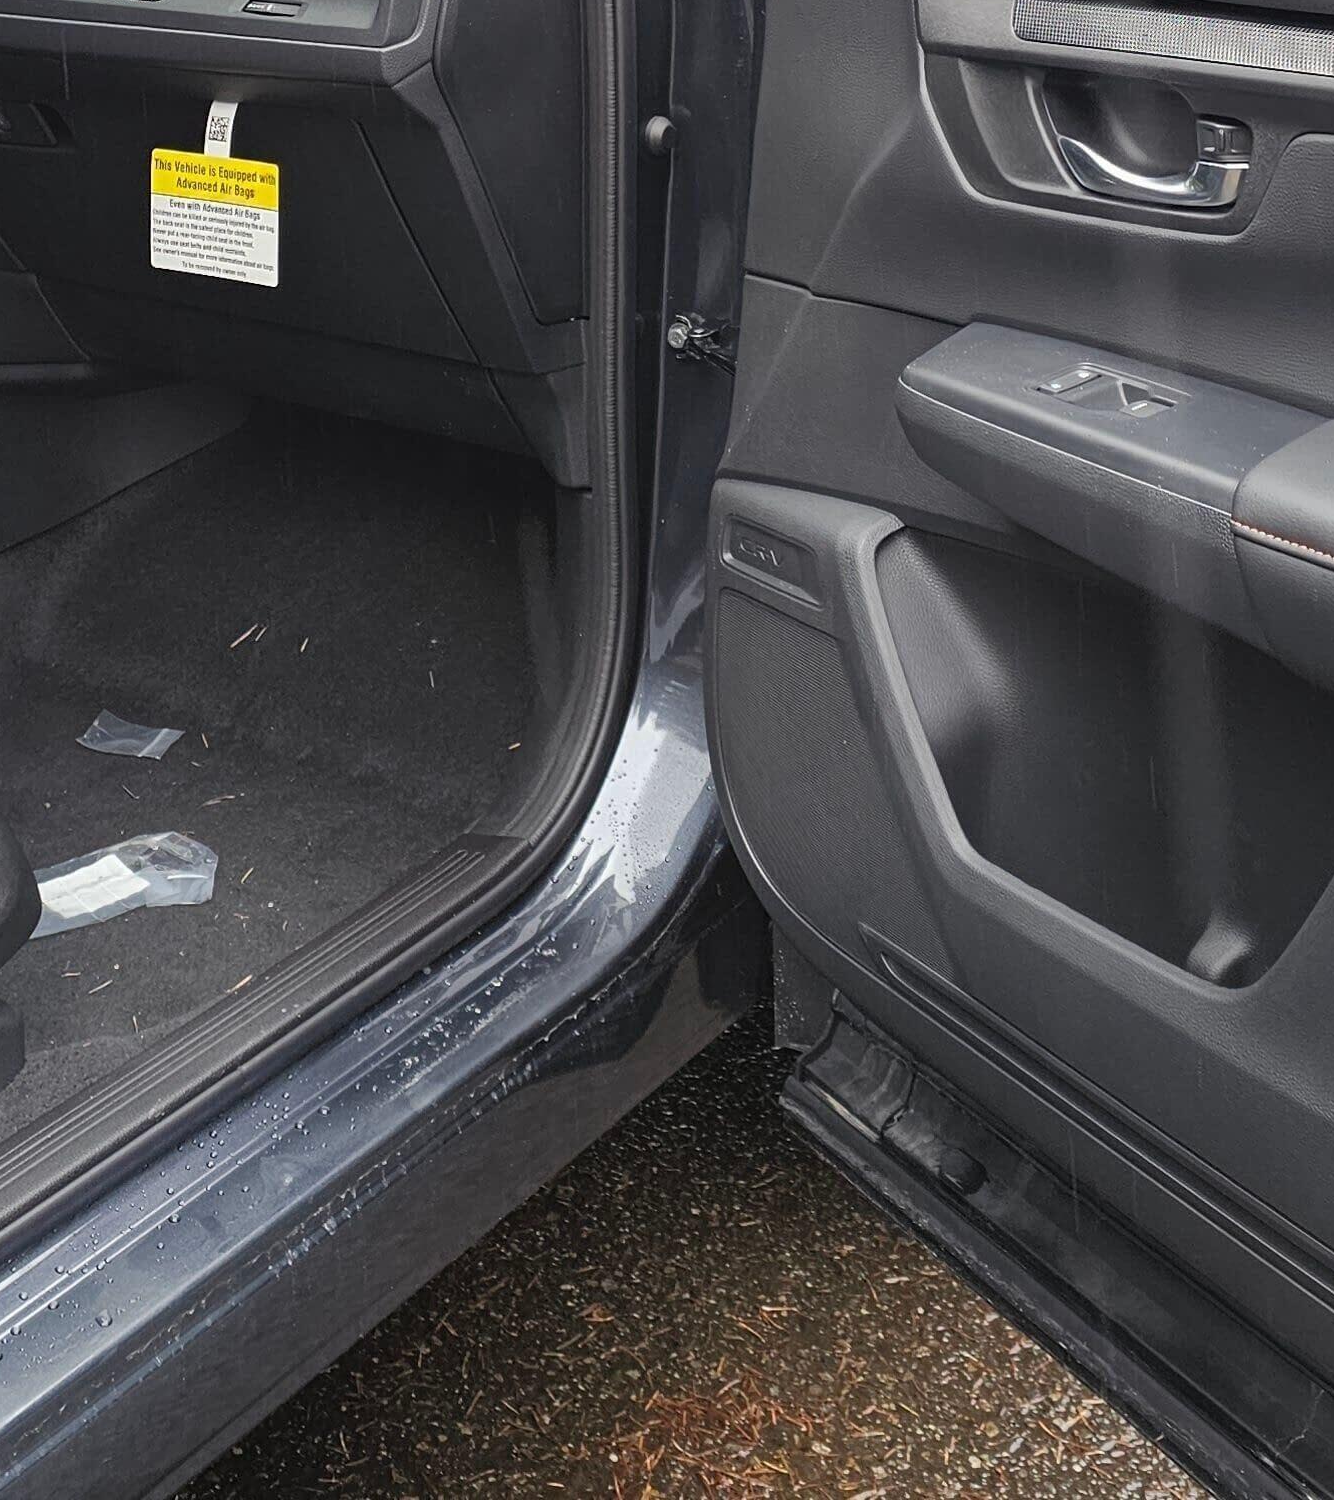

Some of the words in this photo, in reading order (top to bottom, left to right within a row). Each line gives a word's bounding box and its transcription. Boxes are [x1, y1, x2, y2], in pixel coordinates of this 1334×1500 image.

[155, 158, 172, 171] This
[175, 161, 206, 175] Vehicle
[209, 166, 216, 177] is
[219, 167, 257, 184] Equipped
[259, 173, 276, 185] with
[177, 177, 217, 193] Advanced
[220, 183, 232, 194] Air
[235, 185, 255, 199] Bags
[170, 199, 185, 209] Even
[187, 202, 201, 211] with
[203, 204, 232, 215] Advanced
[235, 208, 243, 217] Air
[245, 210, 260, 221] Bags
